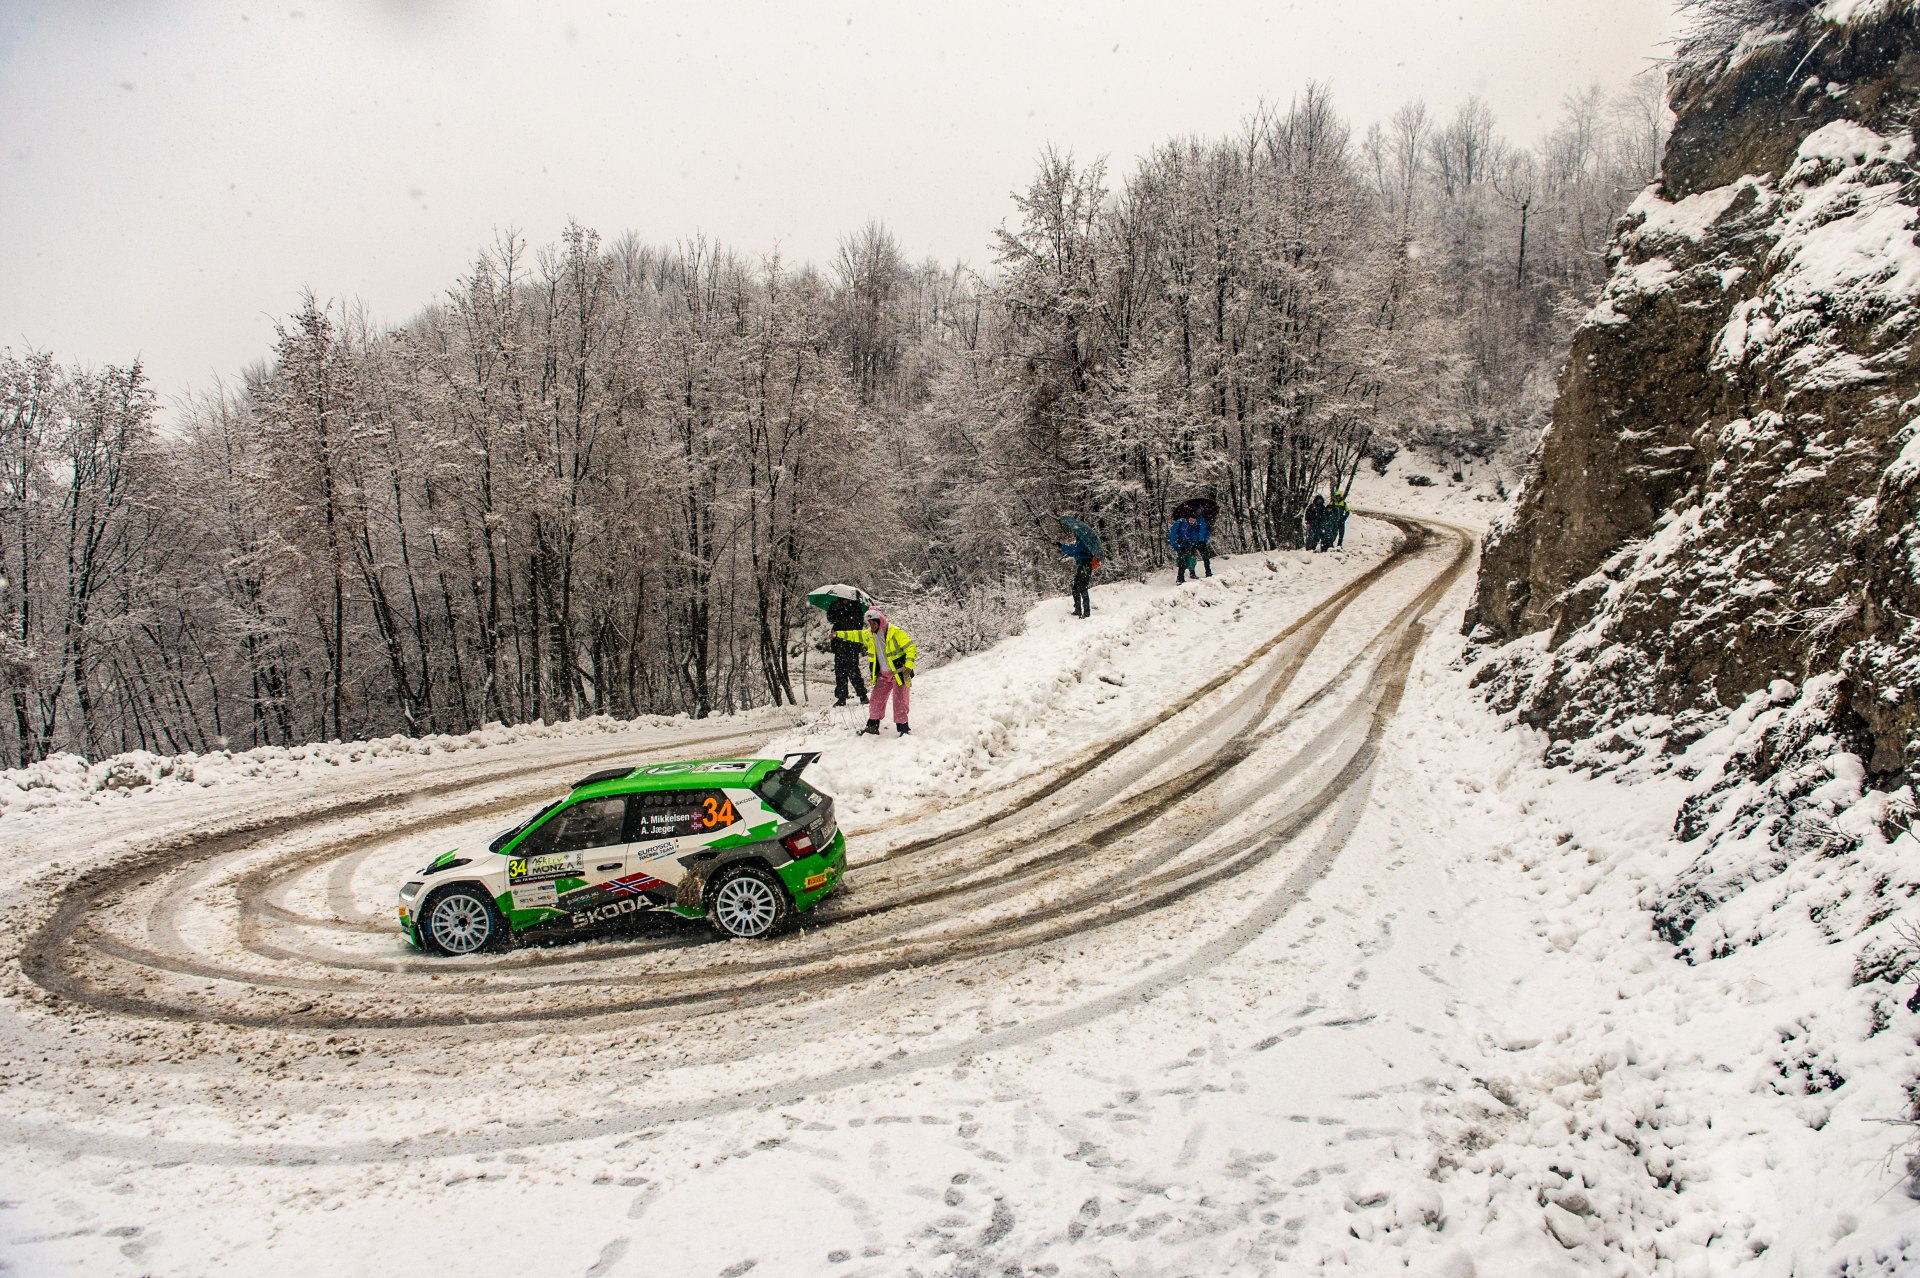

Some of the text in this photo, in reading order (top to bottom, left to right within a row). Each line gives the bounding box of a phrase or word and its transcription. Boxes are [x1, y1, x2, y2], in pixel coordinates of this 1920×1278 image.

[641, 813, 690, 825] A. Mikkelsen
[703, 797, 735, 828] 34
[641, 825, 675, 835] A. Jæger
[638, 842, 672, 857] EUROSOL
[509, 858, 527, 878] 34
[532, 862, 575, 874] MONZA
[573, 894, 653, 929] ŠKODA
